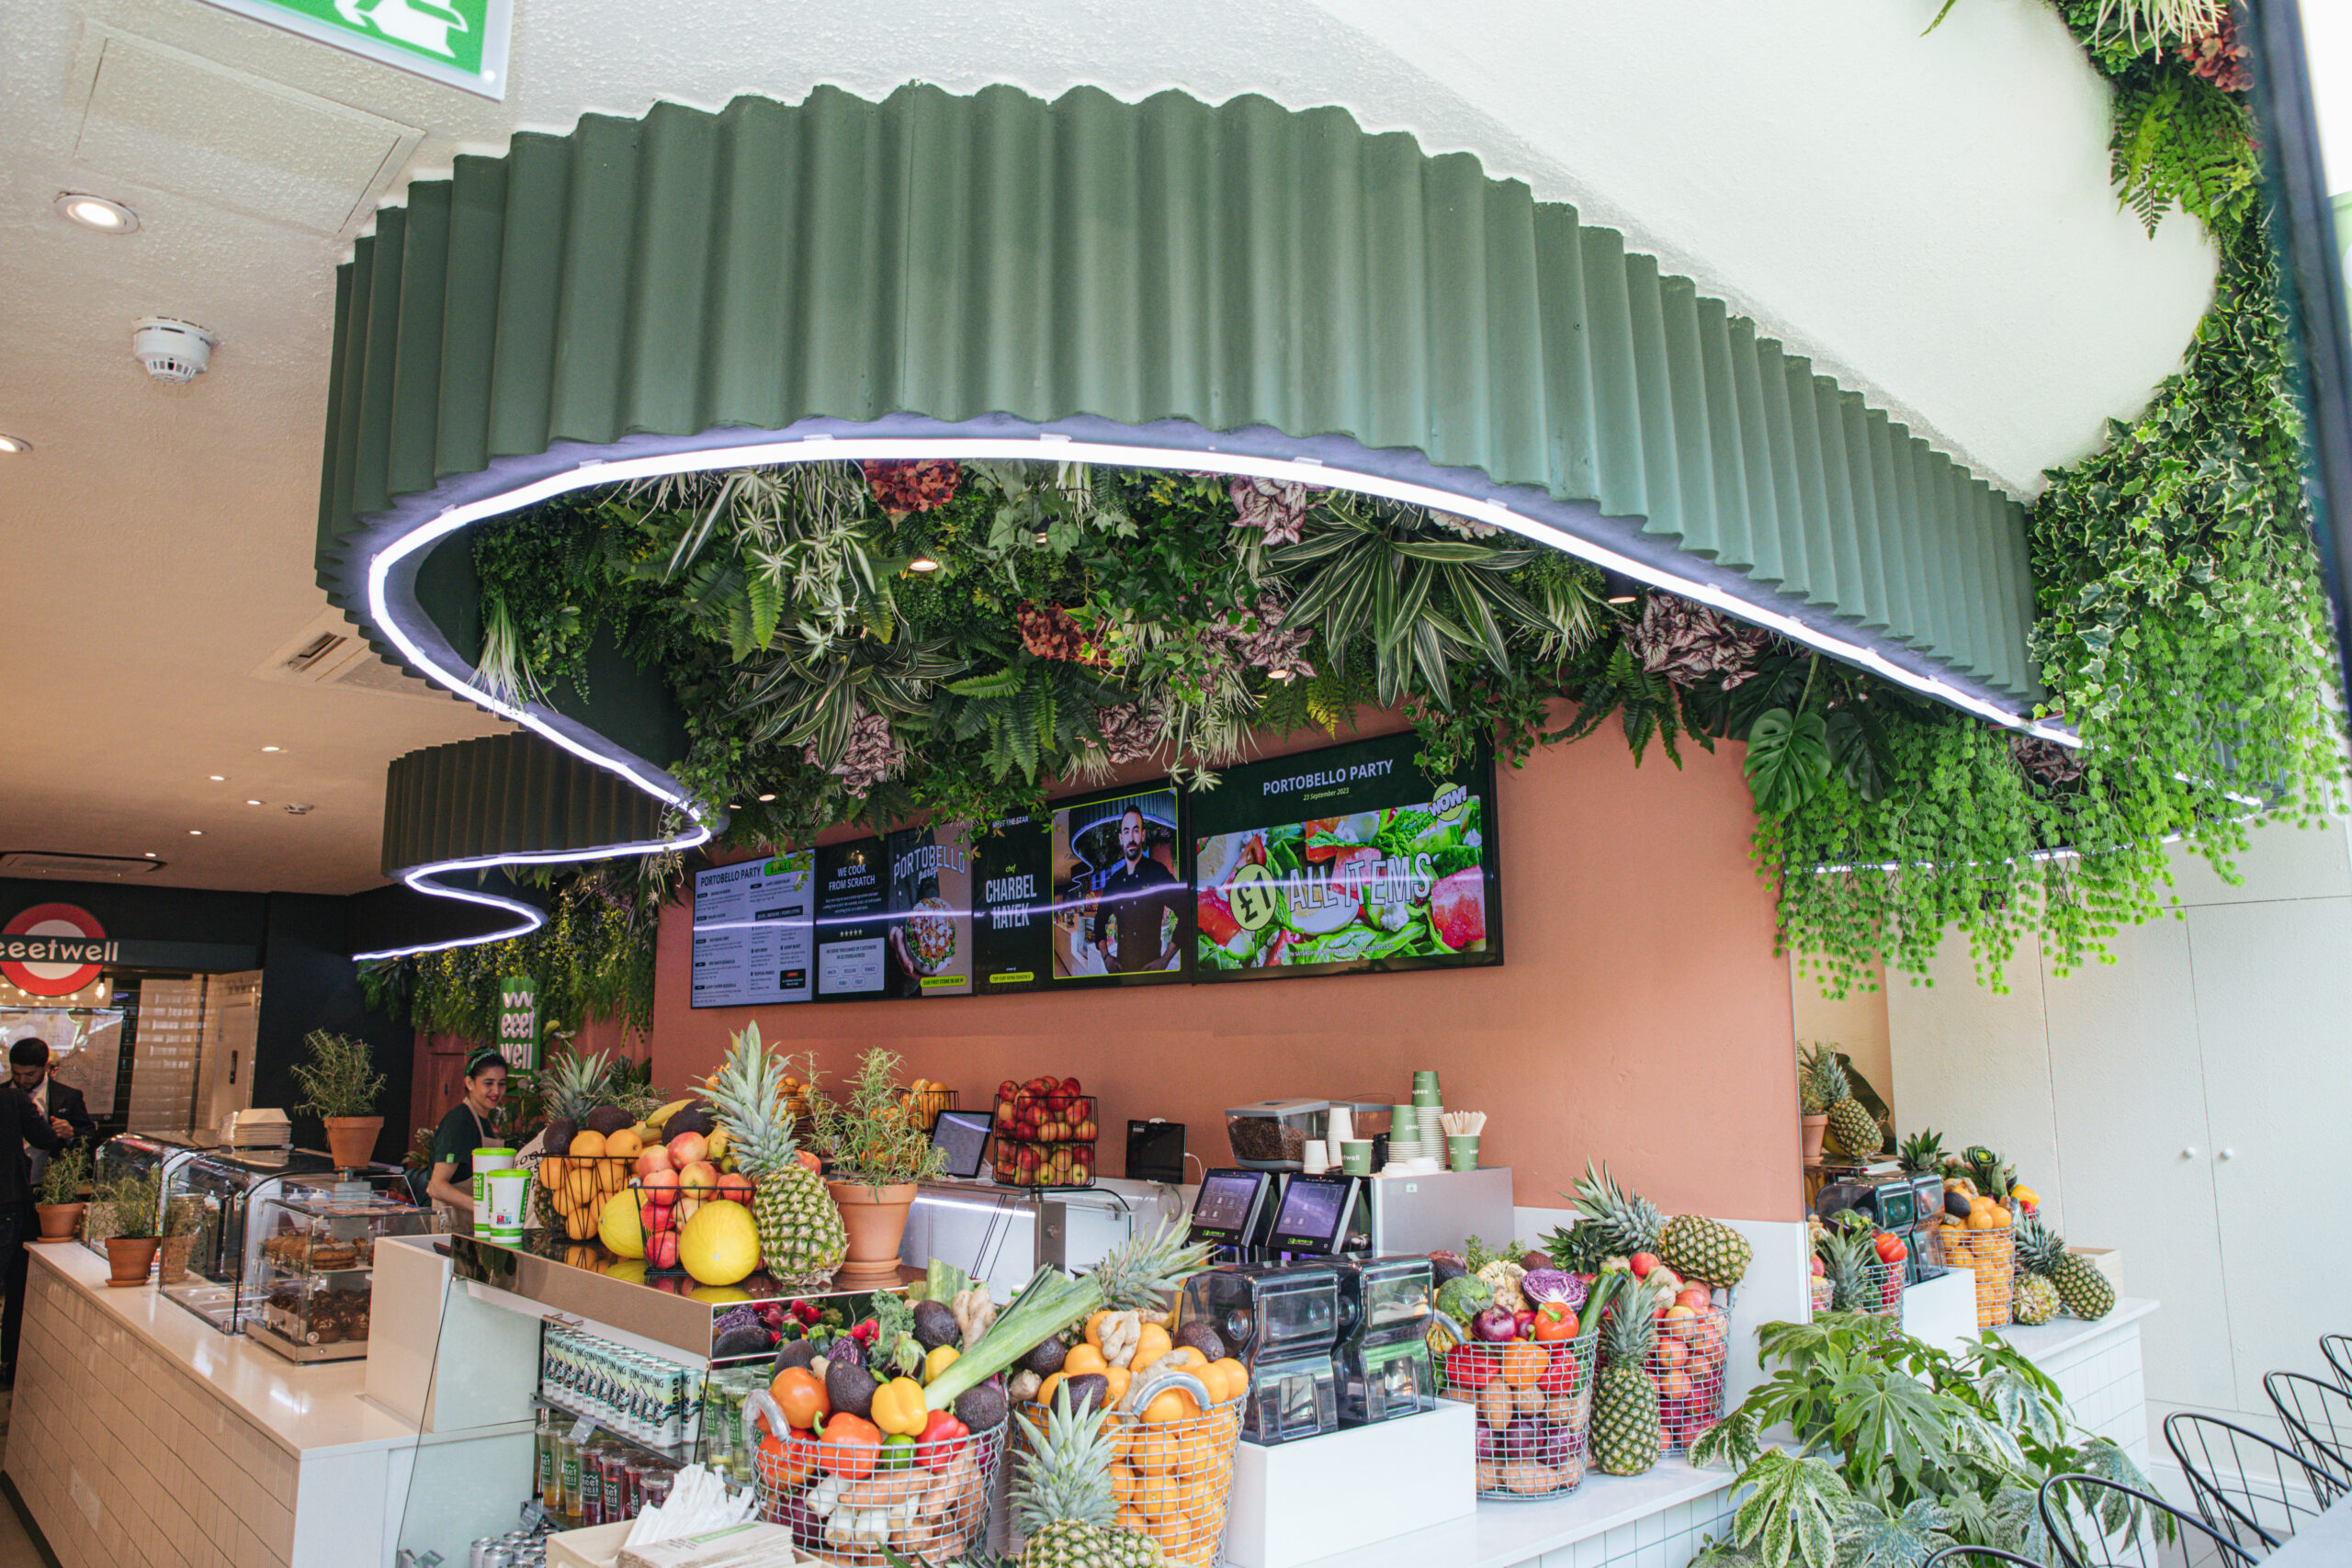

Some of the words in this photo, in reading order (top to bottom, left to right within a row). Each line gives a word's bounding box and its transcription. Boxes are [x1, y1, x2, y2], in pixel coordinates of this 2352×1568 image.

[1262, 768, 1347, 796] PORTOBELLO
[1350, 759, 1394, 781] PARTY
[1303, 793, 1310, 801] 23
[1310, 789, 1336, 801] September
[1337, 786, 1350, 796] 2023
[1428, 784, 1468, 818] WOW!
[700, 869, 740, 887] PORTOBELLO
[741, 866, 762, 879] PARTY
[837, 866, 847, 877] WE
[848, 863, 866, 875] COOK
[893, 844, 965, 886] PORTOBELLO
[829, 879, 846, 891] FROM
[847, 874, 876, 888] SCRATCH
[985, 874, 1037, 904] CHARBEL
[1237, 871, 1272, 924] £1
[1289, 864, 1338, 912] ALL
[1344, 852, 1431, 908] ITEMS
[992, 902, 1030, 930] HAYEK
[0, 939, 119, 962] eetwell
[501, 1008, 535, 1039] eeet
[500, 1043, 532, 1069] well
